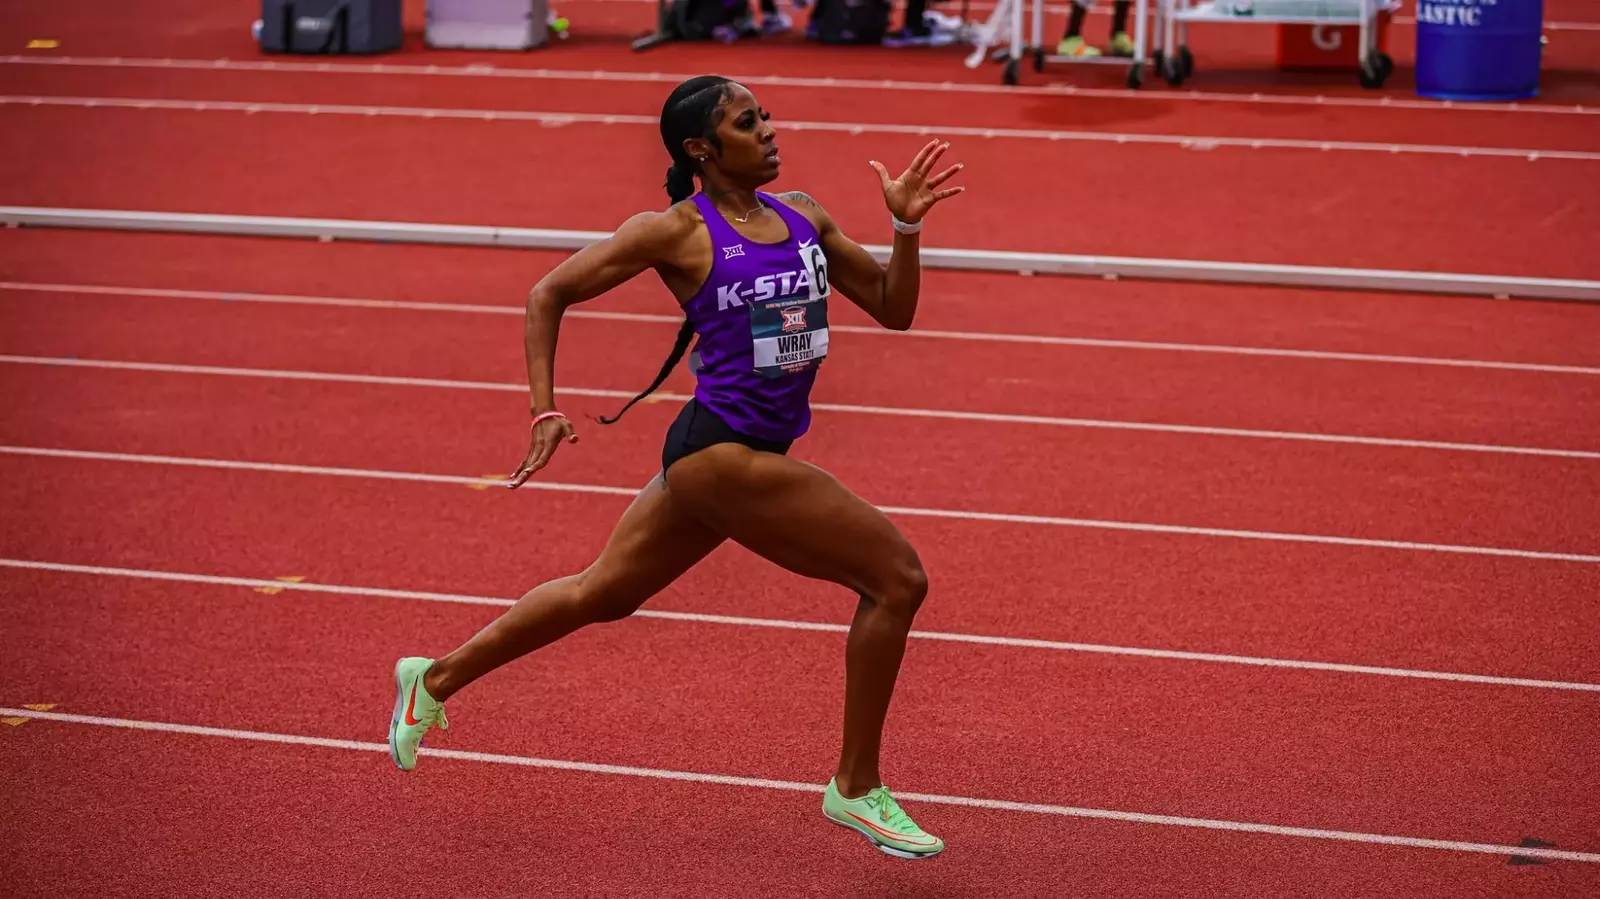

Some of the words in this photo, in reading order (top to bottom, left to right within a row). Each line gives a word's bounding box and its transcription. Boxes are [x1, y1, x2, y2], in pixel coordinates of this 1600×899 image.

[1416, 3, 1482, 26] LASTIC
[811, 248, 827, 296] 6
[717, 269, 810, 311] K-STA
[777, 333, 812, 354] WRAY
[775, 352, 798, 364] KANSAS
[799, 349, 815, 360] STATE
